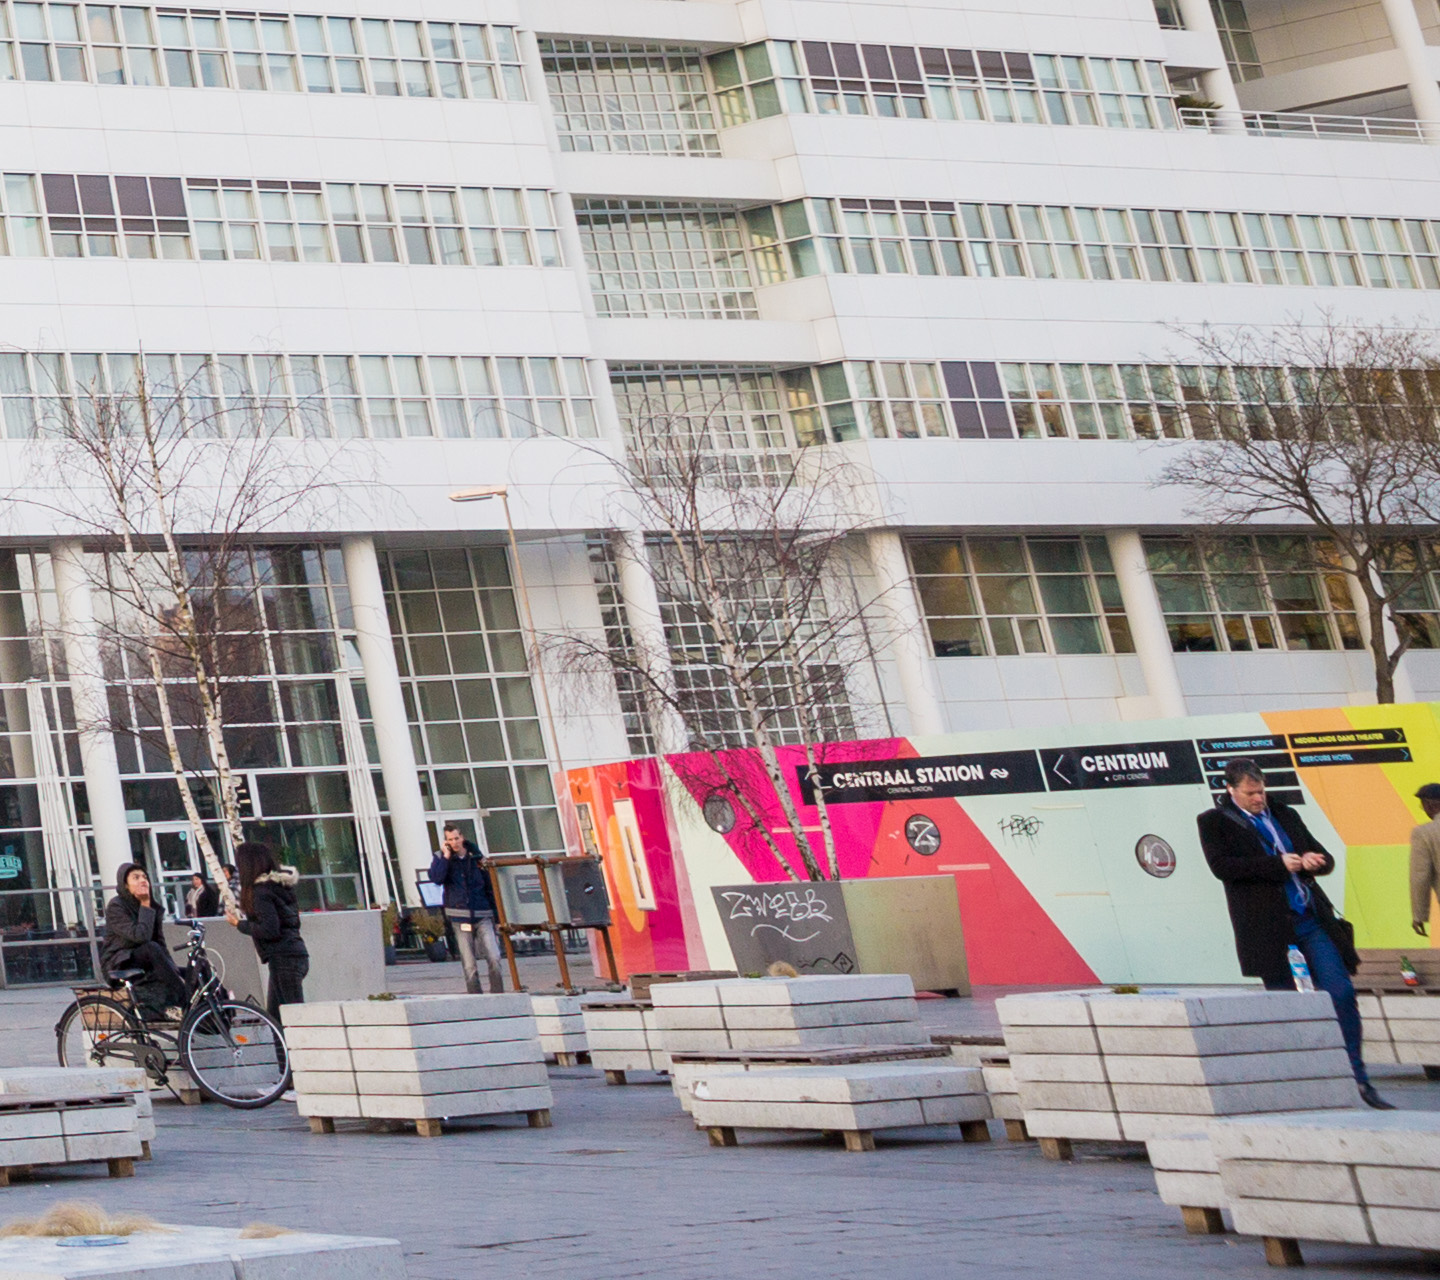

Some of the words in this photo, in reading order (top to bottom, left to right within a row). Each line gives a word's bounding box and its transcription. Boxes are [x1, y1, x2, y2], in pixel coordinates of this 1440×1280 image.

[1226, 740, 1251, 749] TOURIST
[1251, 739, 1274, 747] OFFICE
[1294, 735, 1337, 744] NEDERLANDS
[1337, 734, 1356, 742] DANS
[1081, 752, 1170, 773] CENTRUM
[1299, 754, 1332, 763] MERCURE
[832, 770, 915, 789] CENTRAAL
[916, 764, 984, 783] STATION
[1112, 774, 1126, 782] CITY
[1127, 772, 1150, 781] CENTRE
[887, 786, 911, 794] CENTRAL
[912, 785, 933, 793] STATION
